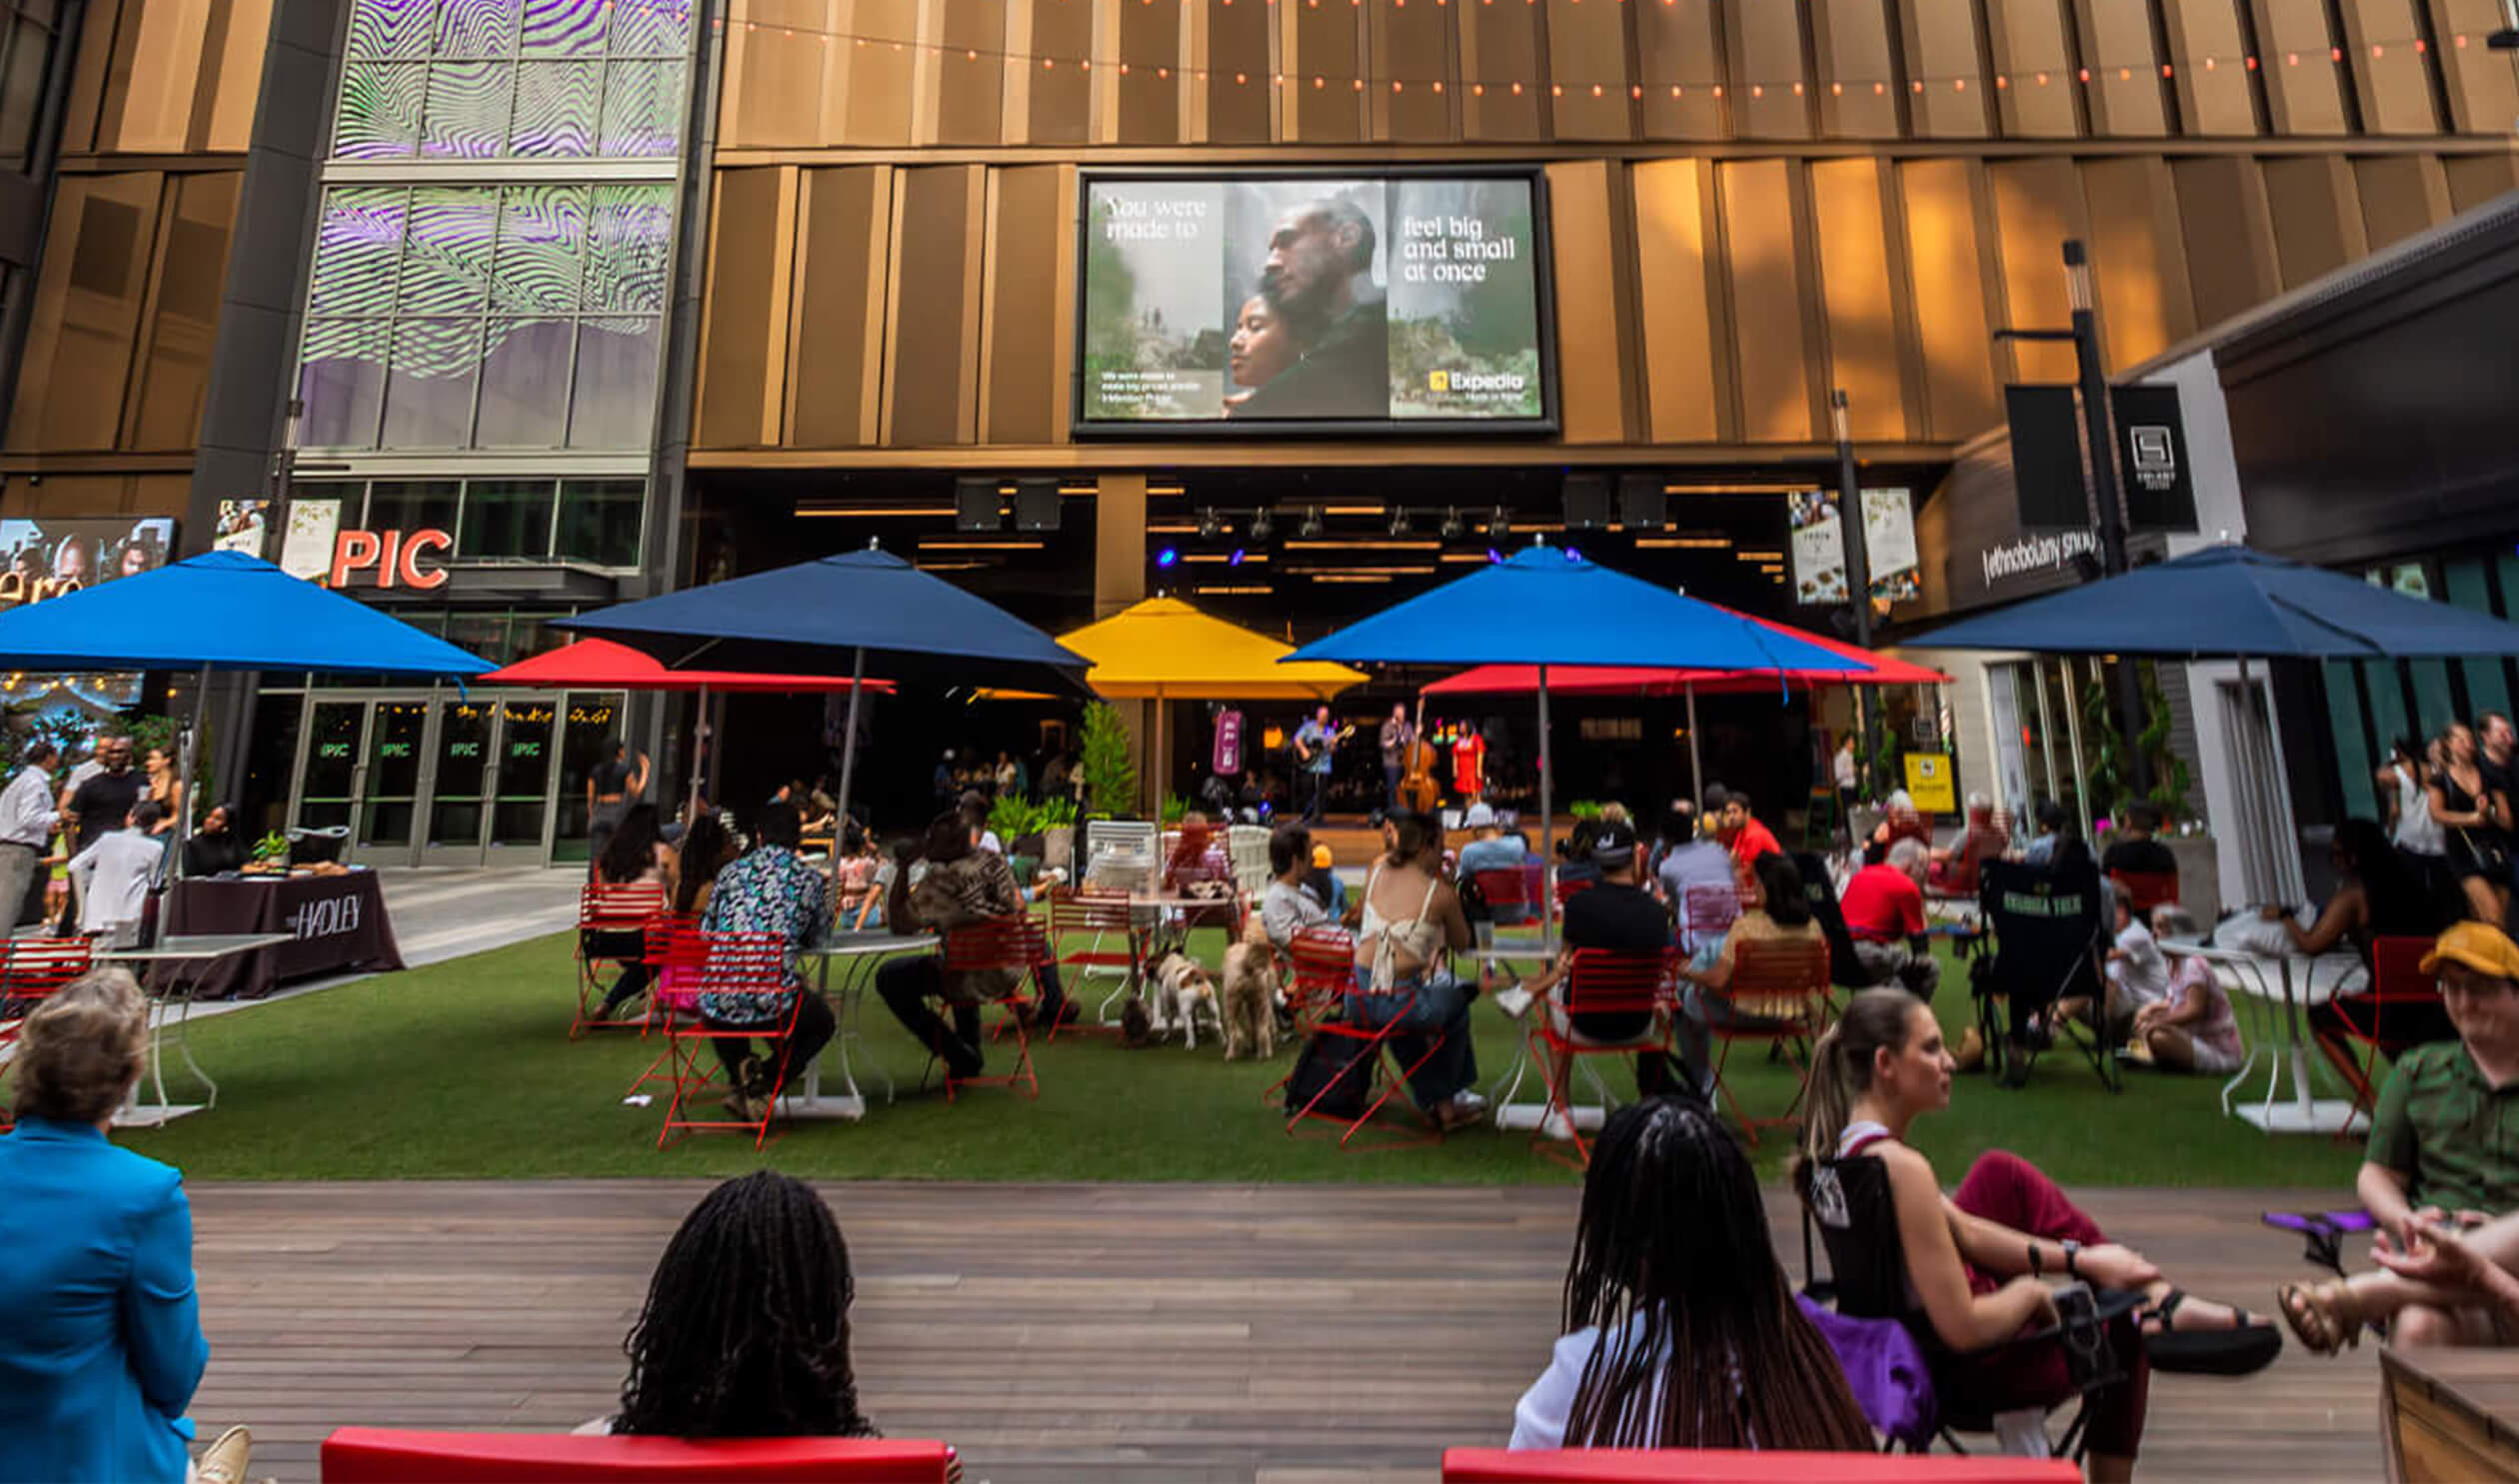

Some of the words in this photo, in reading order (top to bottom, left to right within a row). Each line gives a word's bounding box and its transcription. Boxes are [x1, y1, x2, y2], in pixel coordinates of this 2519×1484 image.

[1107, 197, 1148, 217] You
[1154, 200, 1208, 218] were
[1106, 218, 1169, 239] made
[1175, 220, 1201, 239] to
[1403, 215, 1441, 238] feel
[1448, 215, 1482, 241] big
[1403, 238, 1447, 259] and
[1452, 237, 1515, 259] small
[1404, 263, 1427, 281] at
[1432, 263, 1486, 282] once
[1450, 371, 1524, 392] Expedia
